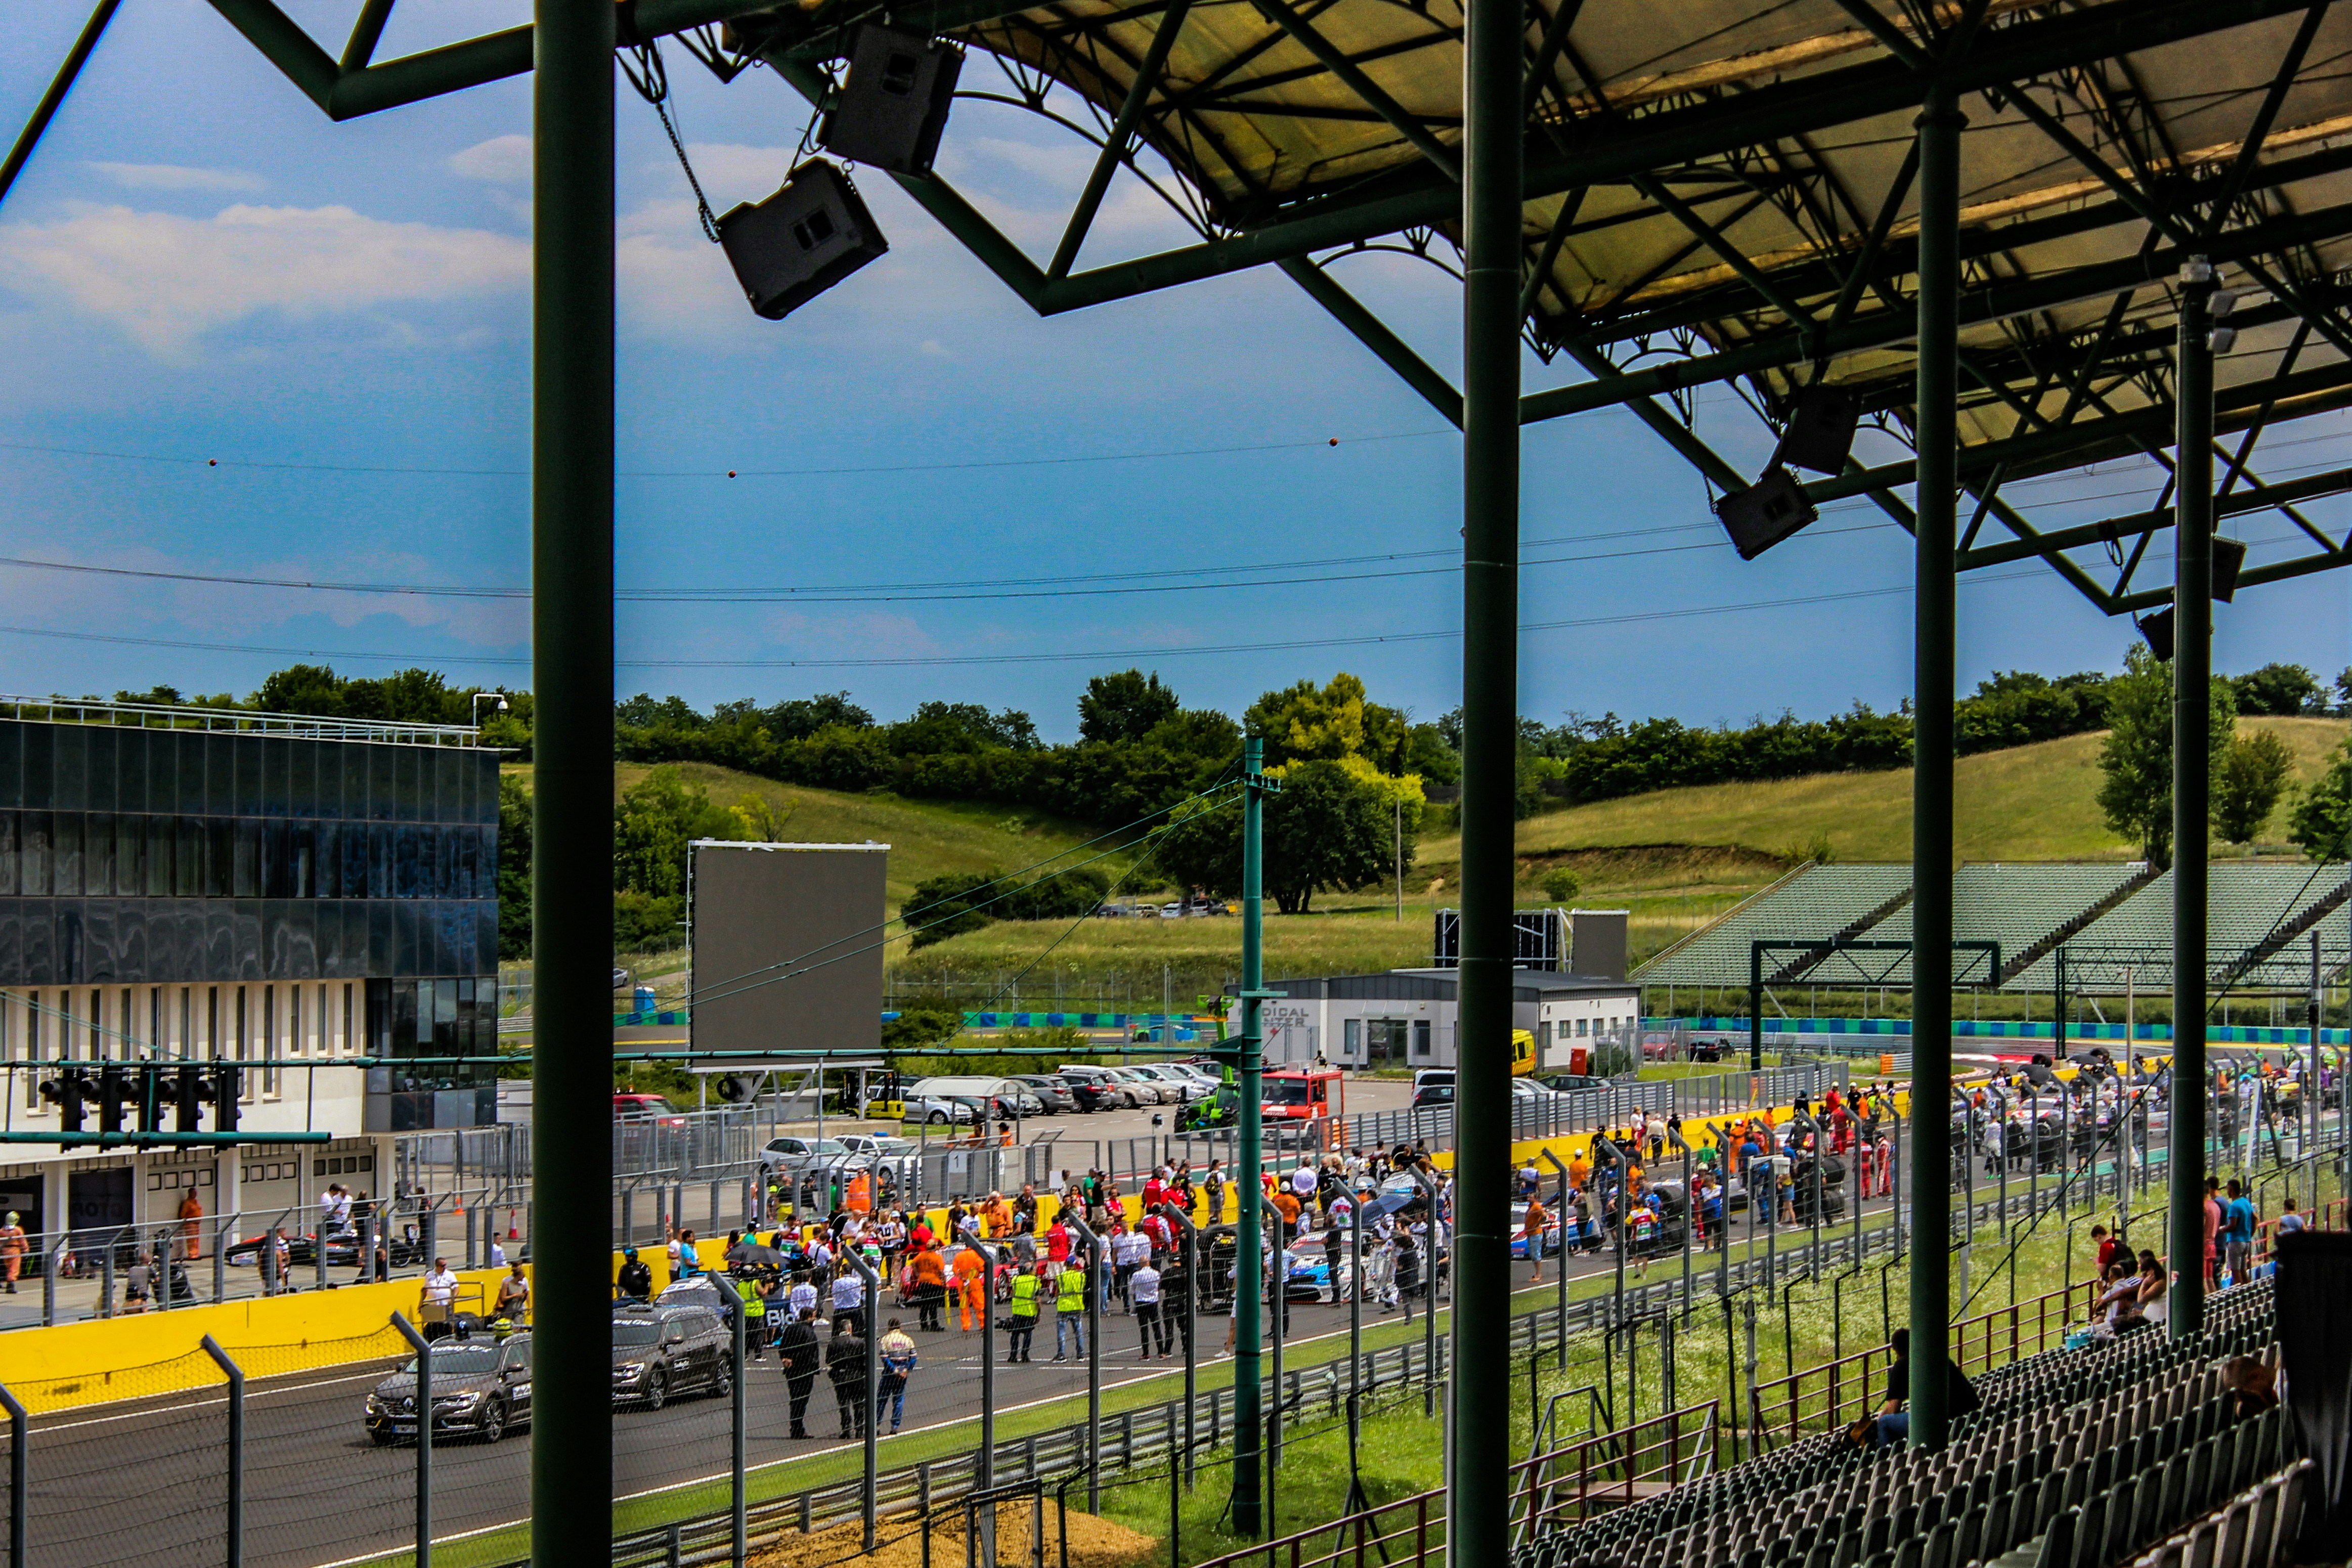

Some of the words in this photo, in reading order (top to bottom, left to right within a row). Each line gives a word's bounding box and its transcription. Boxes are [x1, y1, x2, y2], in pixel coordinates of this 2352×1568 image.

[1239, 1008, 1309, 1017] DICAL
[1262, 1018, 1305, 1027] NTER
[954, 1154, 959, 1168] 1
